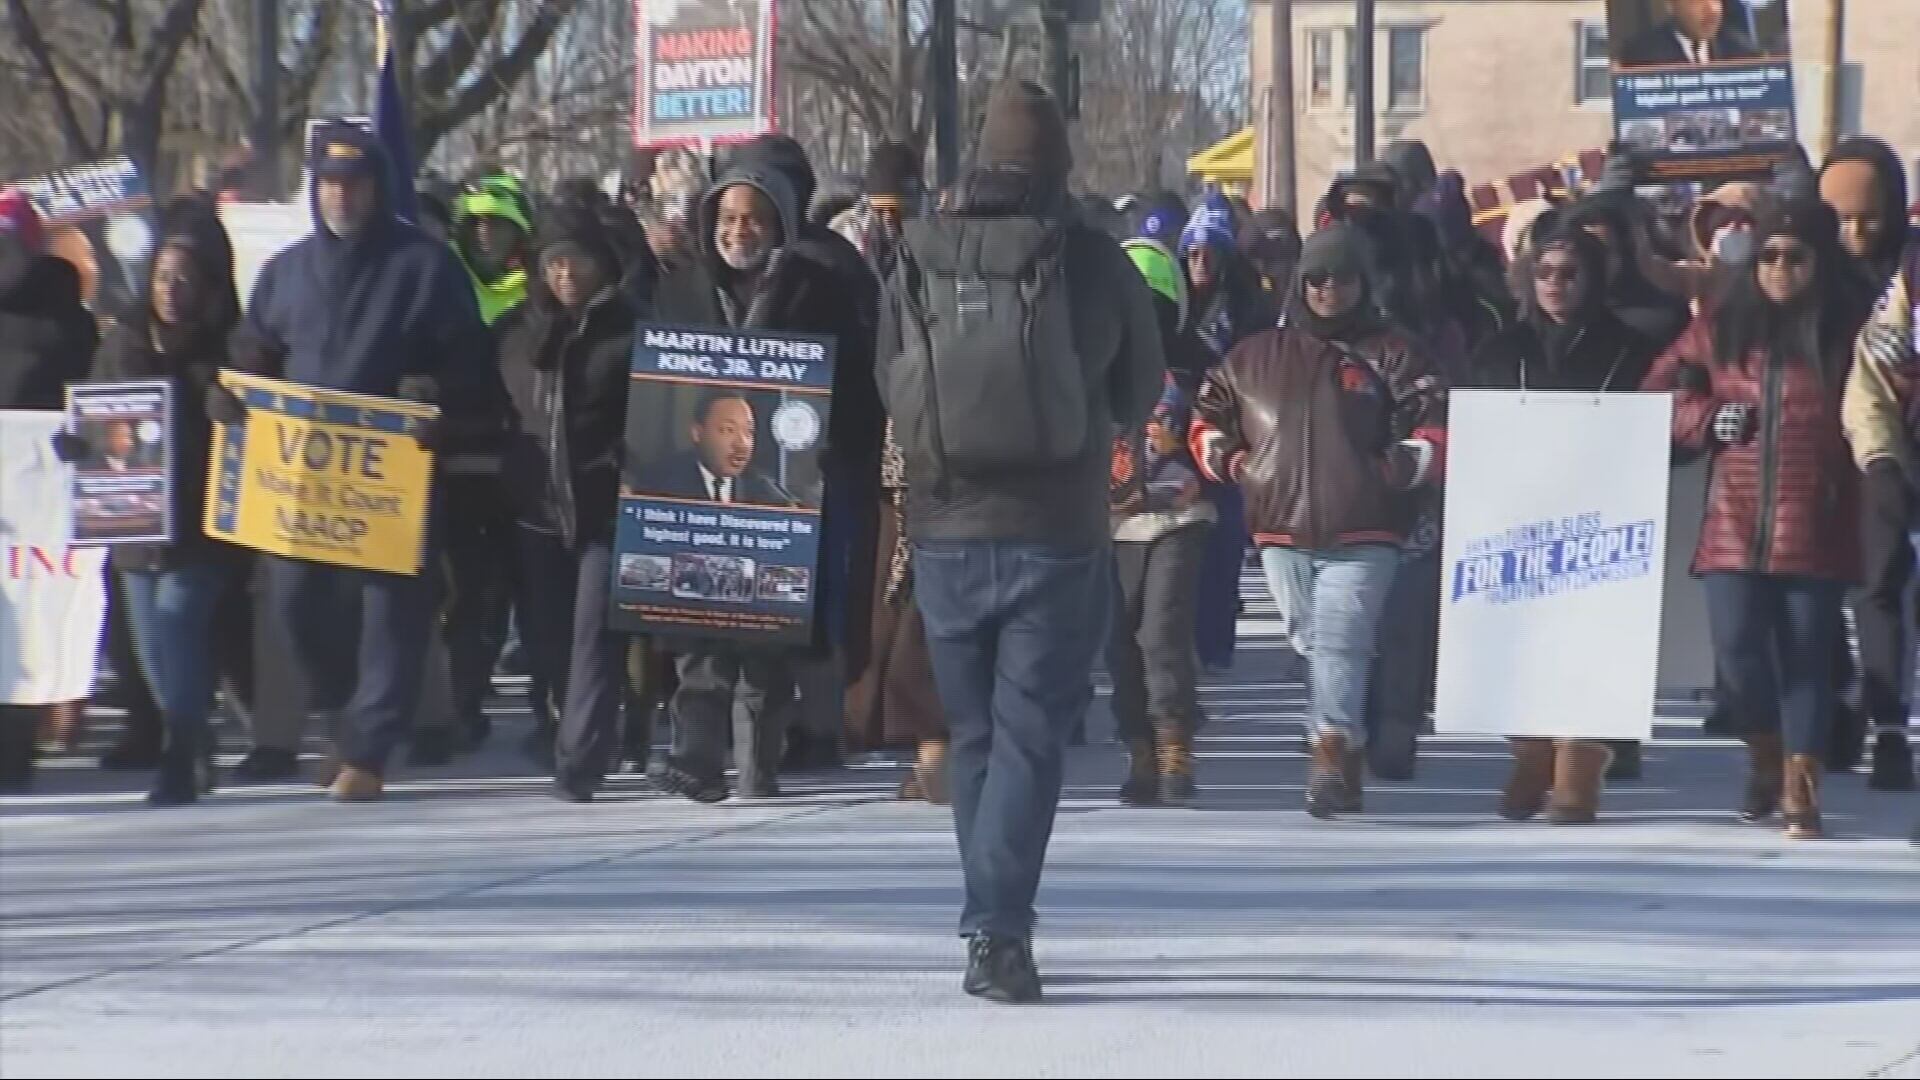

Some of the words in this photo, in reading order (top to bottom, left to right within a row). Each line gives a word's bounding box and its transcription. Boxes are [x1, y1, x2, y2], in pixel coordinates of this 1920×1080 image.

[656, 27, 753, 59] MAKING
[654, 57, 752, 90] DAYTON
[654, 86, 751, 118] BETTER!
[644, 330, 733, 354] MARTIN
[737, 337, 826, 361] LUTHER
[657, 352, 718, 377] KING,
[722, 358, 755, 376] JR.
[760, 360, 808, 380] DAY
[276, 422, 390, 481] VOTE
[341, 487, 402, 516] Count
[277, 508, 369, 544] NAACP
[643, 507, 676, 522] think
[687, 511, 717, 526] have
[719, 514, 789, 532] Discovered
[791, 520, 813, 534] the
[643, 526, 690, 543] highest
[743, 536, 754, 548] is
[1461, 554, 1504, 593] FOR
[1513, 543, 1556, 582] THE
[1560, 522, 1654, 571] PEOPLE!
